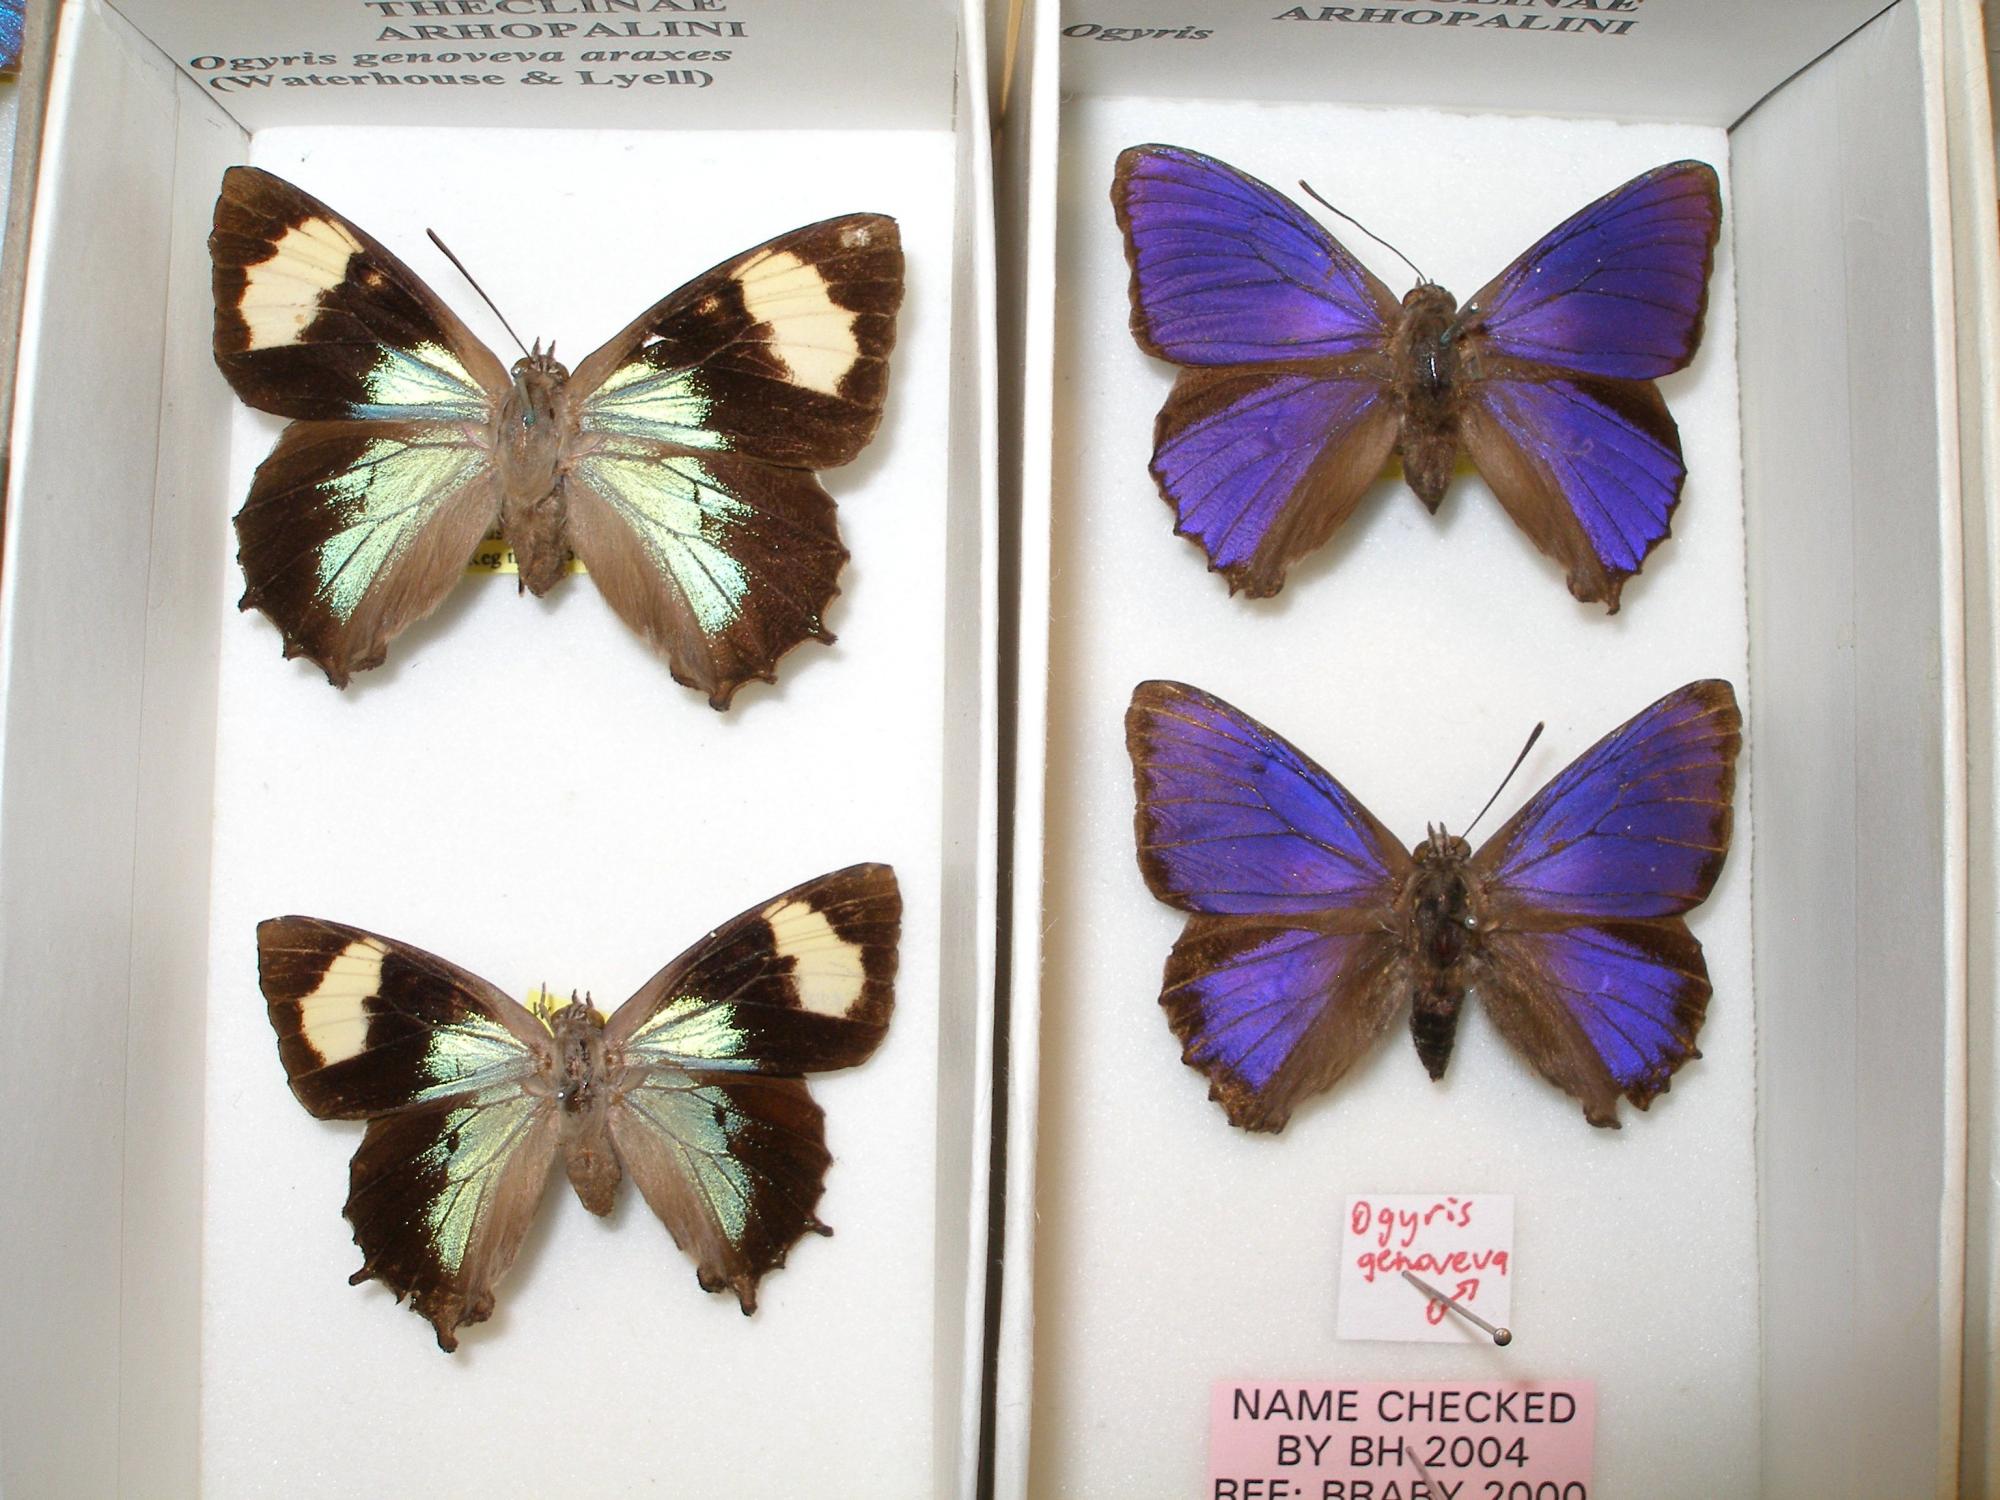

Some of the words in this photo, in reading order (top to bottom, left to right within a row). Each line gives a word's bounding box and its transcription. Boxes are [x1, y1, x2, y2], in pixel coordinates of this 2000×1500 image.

[365, 0, 728, 18] THECLINAE
[1271, 6, 1640, 36] ARHOPALINI
[375, 21, 750, 41] ARHOPALINI
[1062, 23, 1214, 42] Ogyris
[190, 50, 337, 71] Ogyris
[352, 49, 566, 68] genoveva
[578, 47, 733, 63] araxes
[208, 69, 506, 93] (Waterhouse
[518, 69, 562, 85] &
[574, 69, 716, 89] Lyell)
[1350, 1197, 1475, 1248] Ogyris
[1355, 1248, 1510, 1283] genoveva
[1232, 1388, 1360, 1422] NAME
[1377, 1390, 1577, 1424] CHECKED
[1276, 1434, 1333, 1467] BY
[1350, 1436, 1405, 1467] BH
[1423, 1435, 1530, 1468] 2004
[1214, 1478, 1302, 1500] REF:
